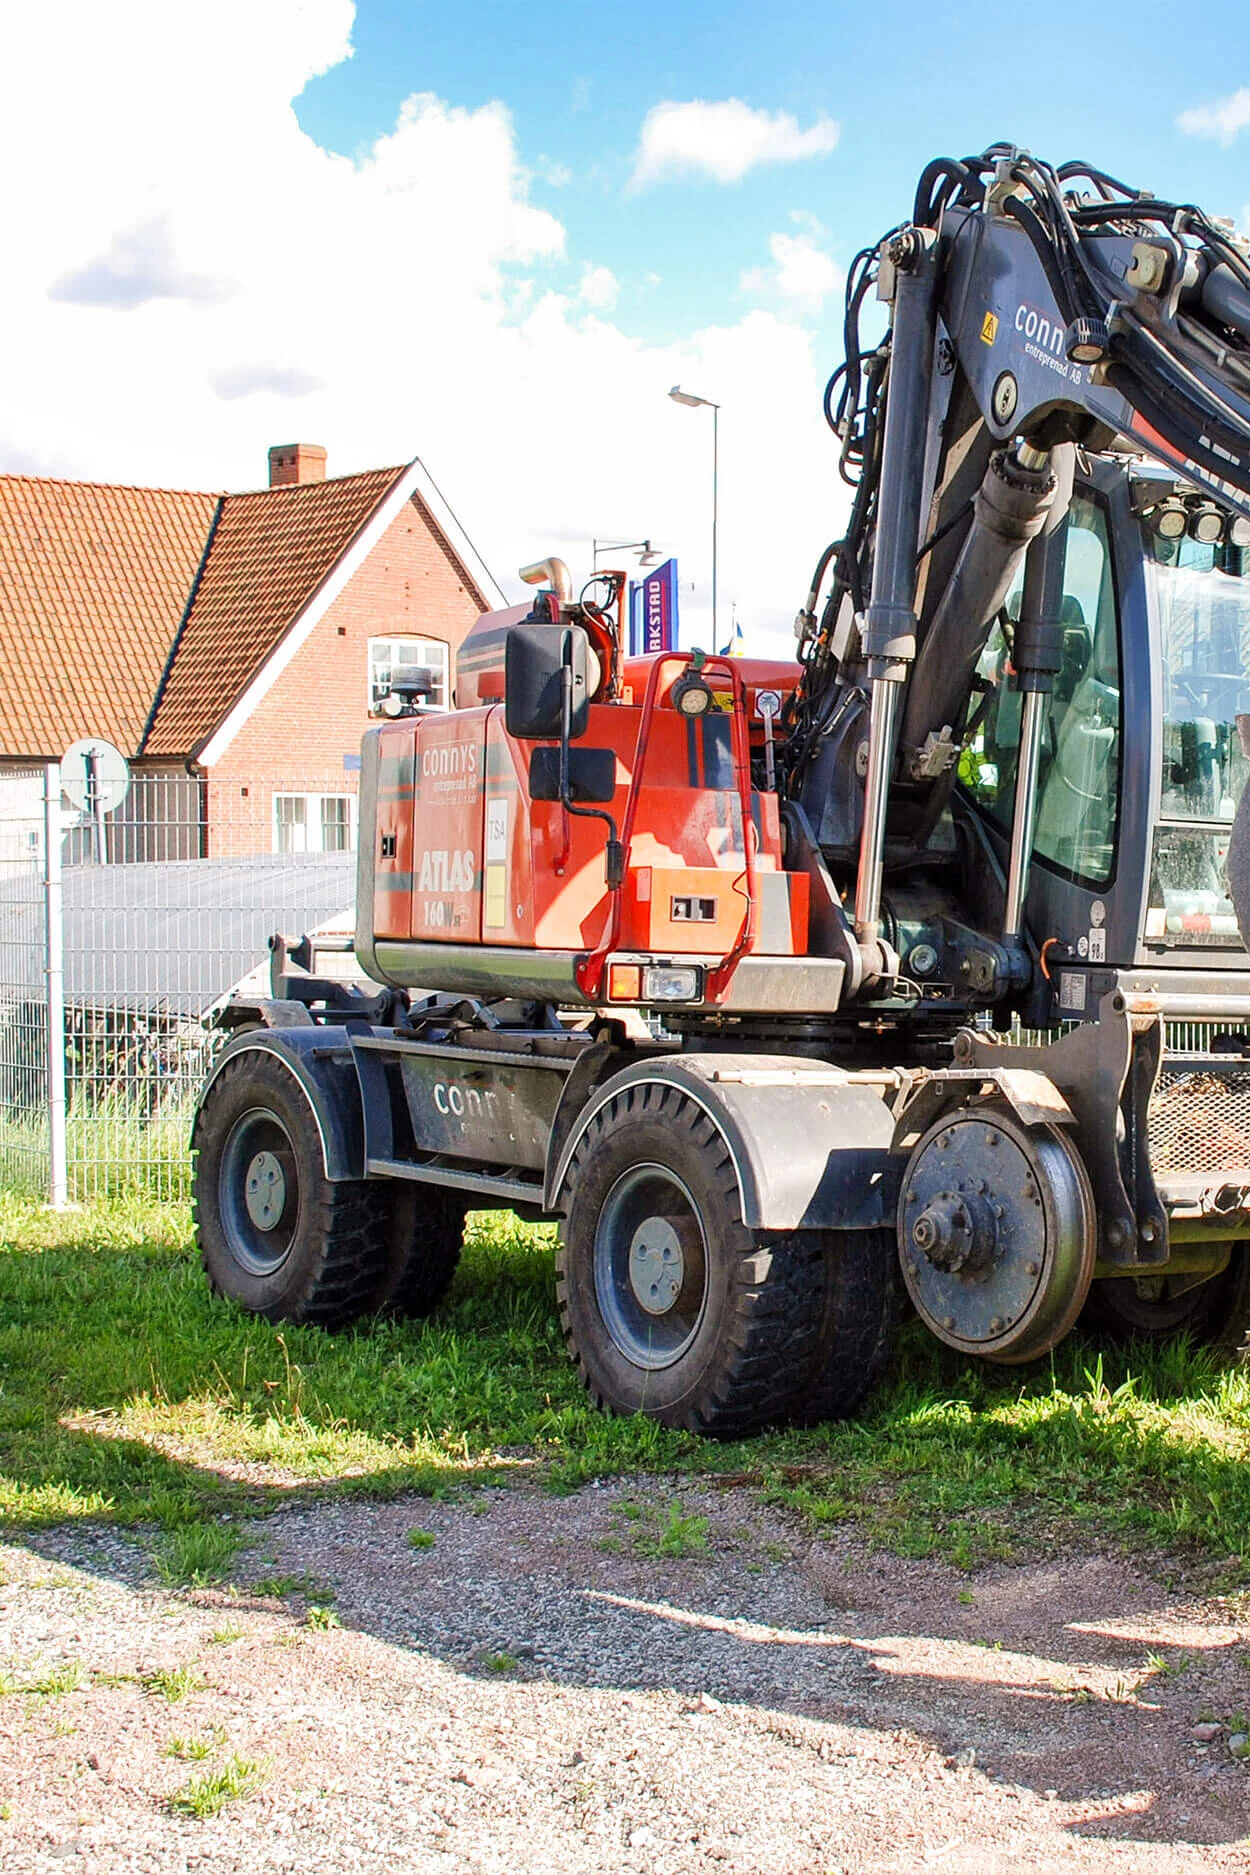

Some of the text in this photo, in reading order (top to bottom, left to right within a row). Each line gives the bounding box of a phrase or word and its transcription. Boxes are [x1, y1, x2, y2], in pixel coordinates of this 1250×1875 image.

[1015, 305, 1070, 361] conn
[1025, 343, 1082, 385] entreprenad AB
[649, 581, 661, 651] RKSTAD
[418, 849, 475, 893] ATLAS
[433, 1083, 498, 1119] conn
